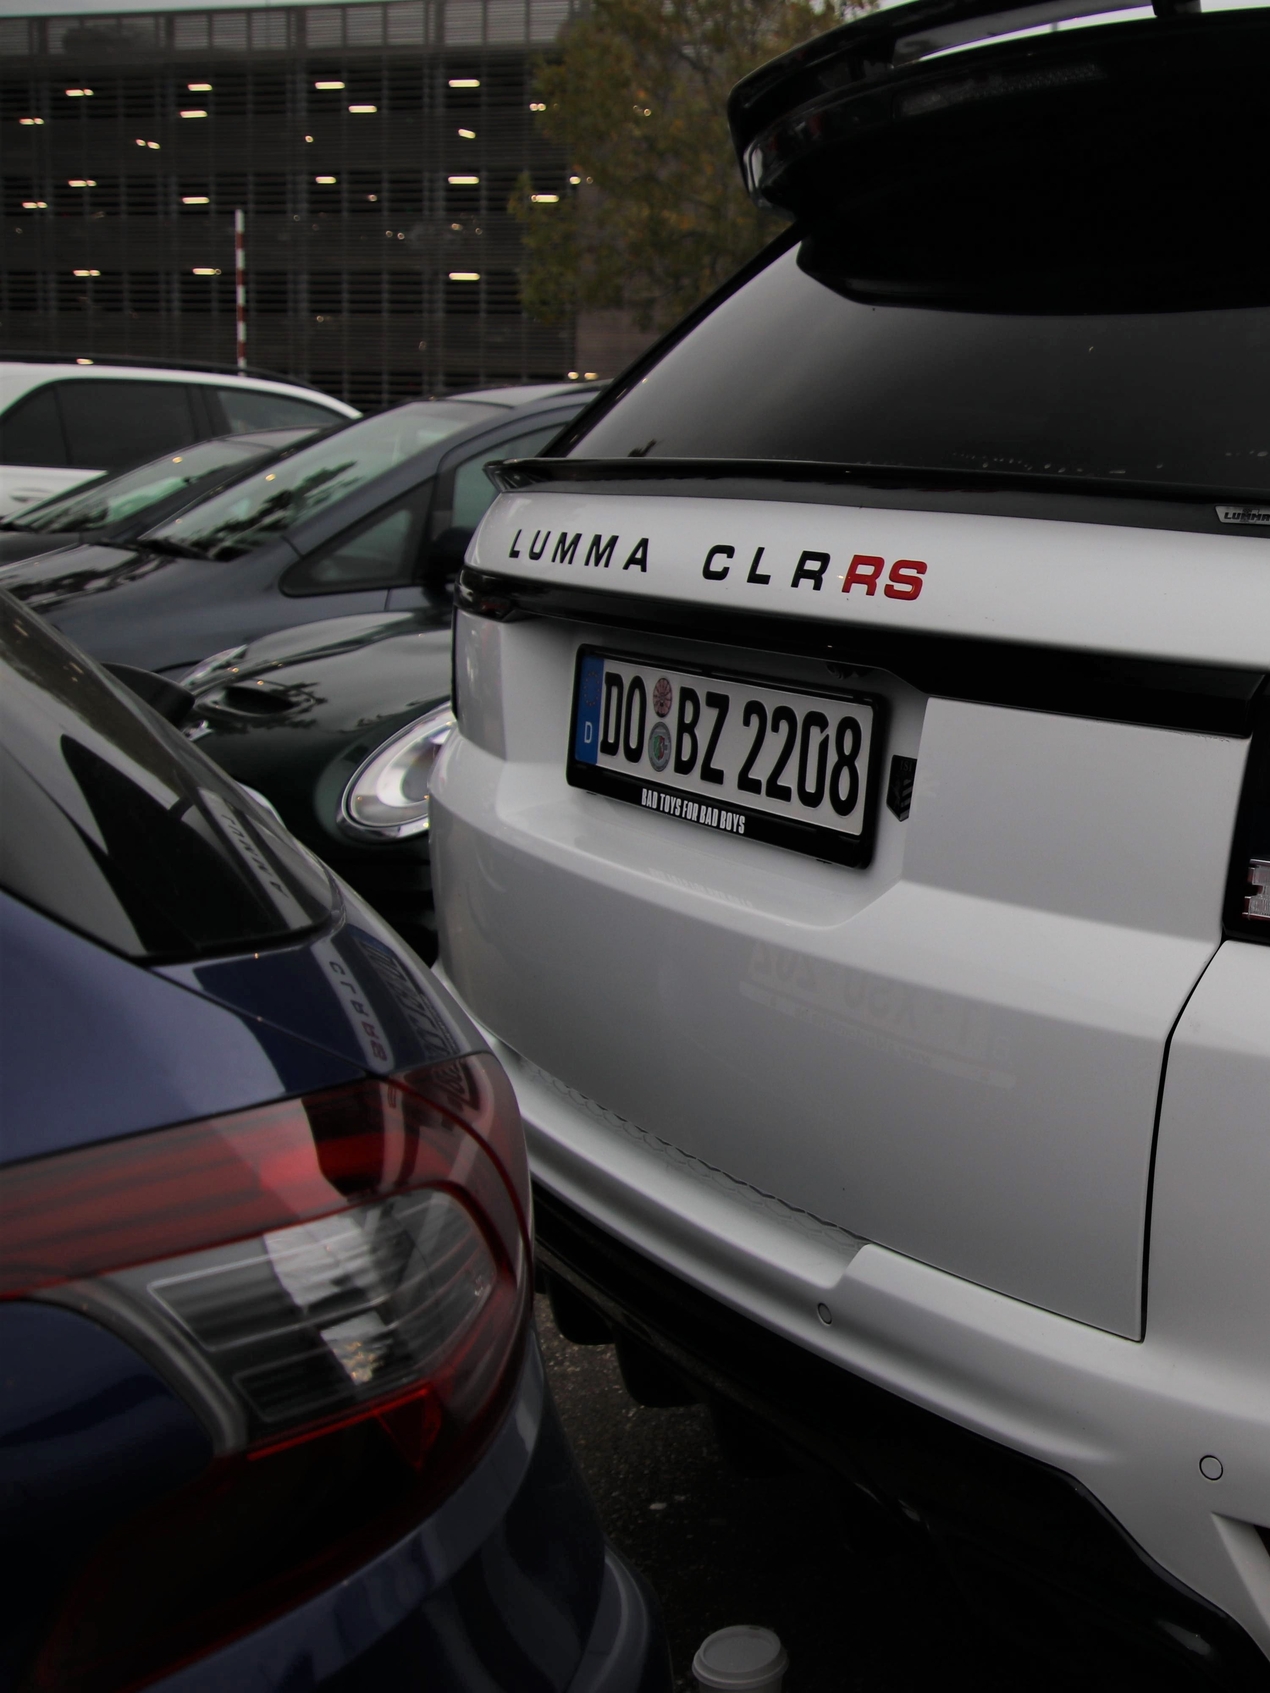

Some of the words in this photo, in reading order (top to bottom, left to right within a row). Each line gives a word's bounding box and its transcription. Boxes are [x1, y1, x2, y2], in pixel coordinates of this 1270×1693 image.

[509, 528, 650, 573] LUMMA
[583, 721, 593, 744] D
[599, 671, 647, 764] DO
[674, 685, 730, 785] BZ
[737, 699, 861, 817] 2208
[641, 788, 658, 809] BAD
[660, 793, 682, 816] TOYS
[682, 800, 699, 821] FOR
[699, 805, 719, 827] BAD
[720, 811, 745, 834] BOYS
